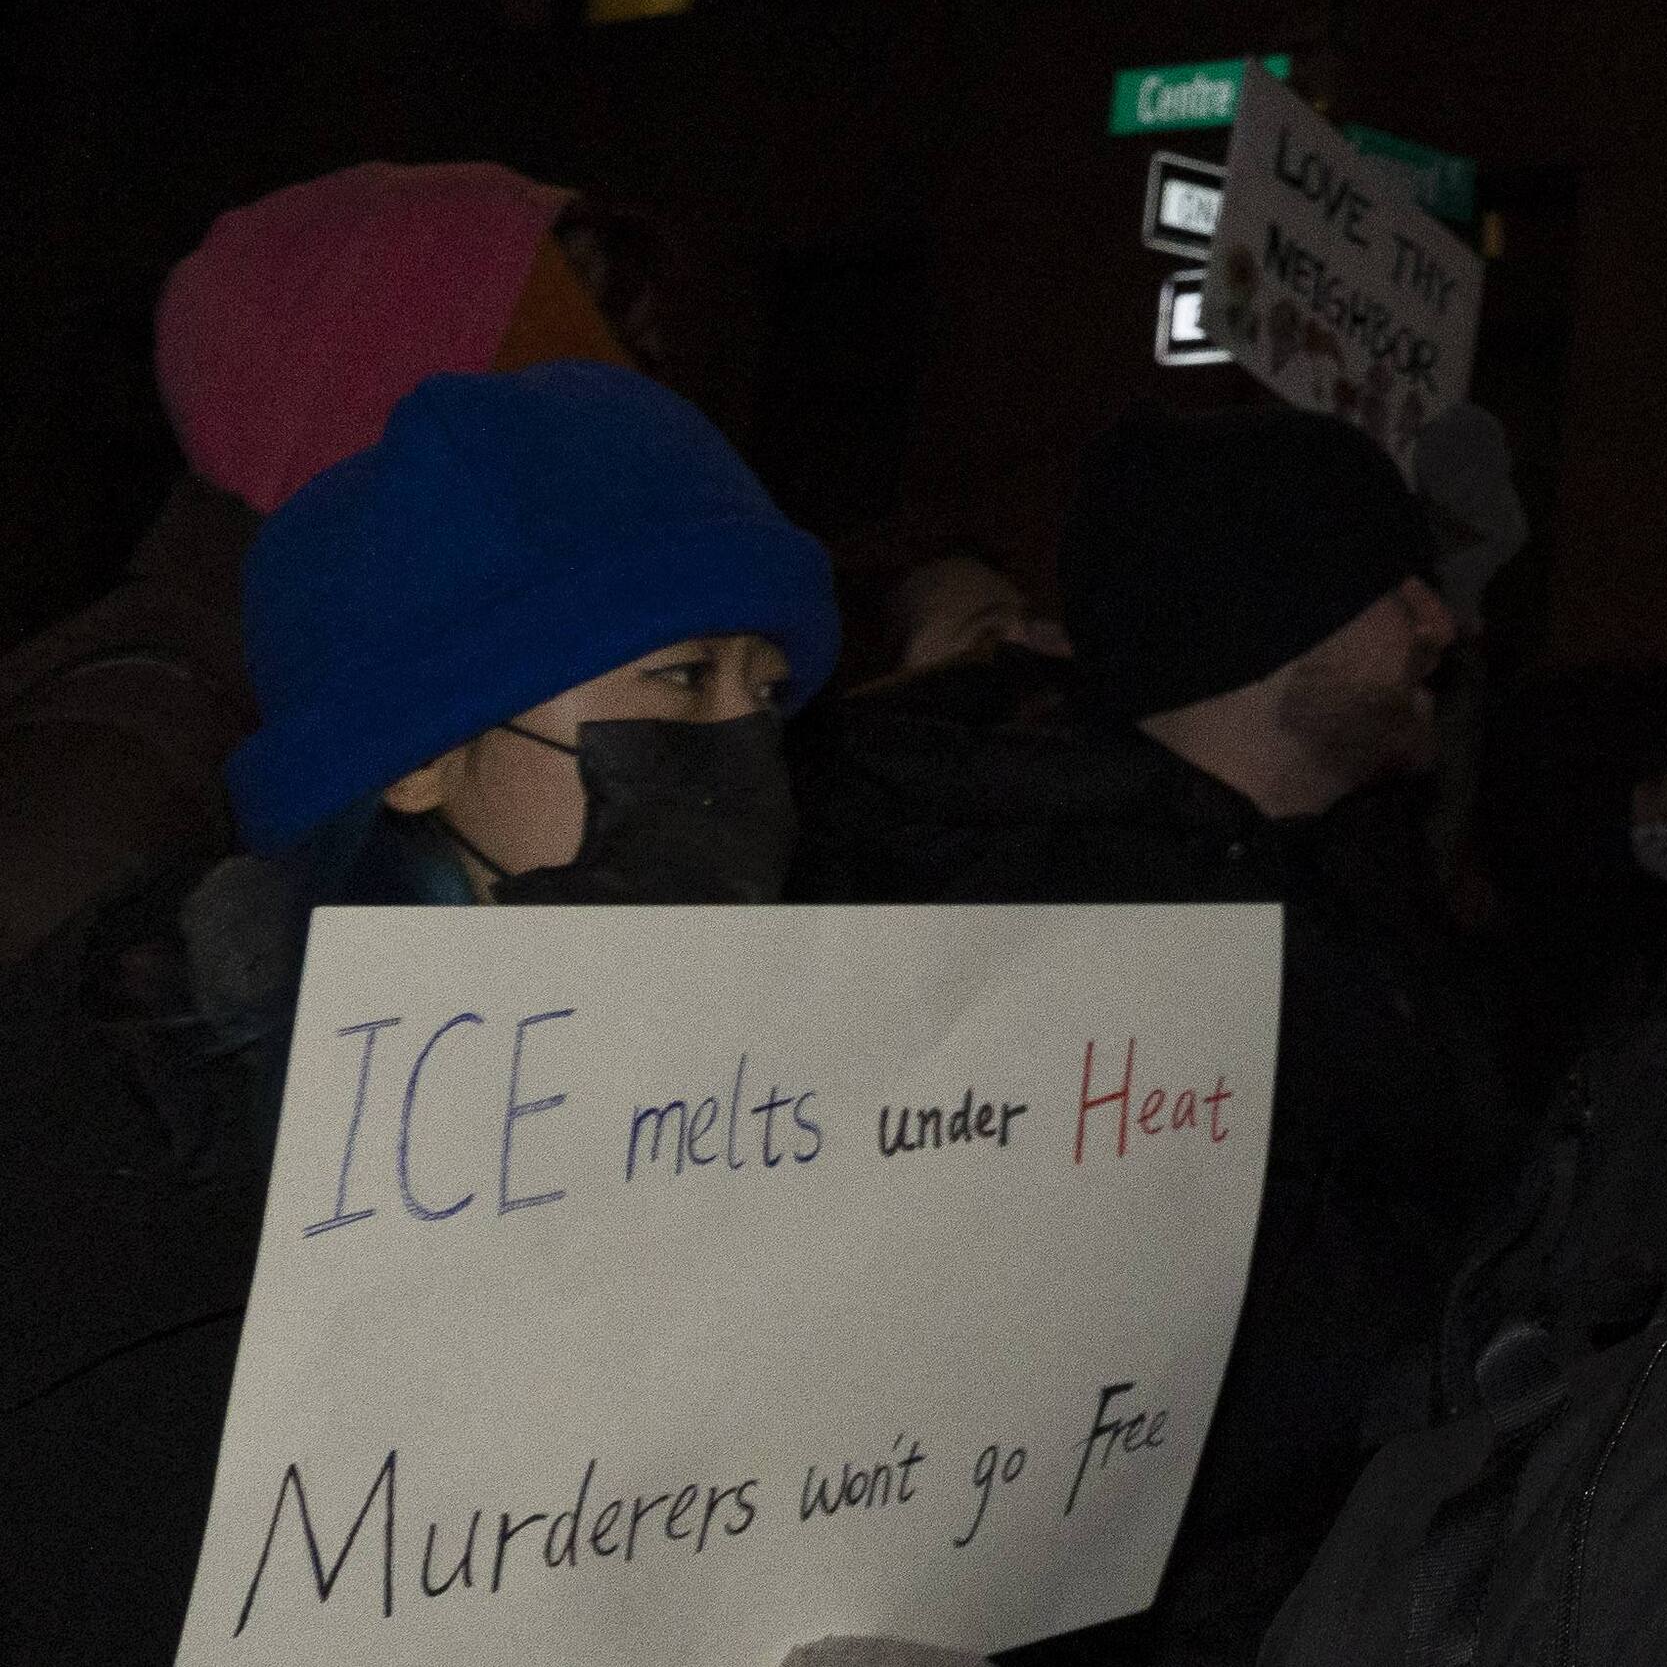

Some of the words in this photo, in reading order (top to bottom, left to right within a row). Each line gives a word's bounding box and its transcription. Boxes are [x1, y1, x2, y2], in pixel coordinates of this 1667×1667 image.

[1273, 126, 1373, 250] LOVE
[1390, 232, 1460, 316] THY
[302, 1008, 577, 1238] ICE
[624, 1053, 825, 1184] melts
[876, 1096, 1029, 1159] under
[1073, 1036, 1235, 1165] Heat
[233, 1448, 760, 1640] Murderers
[799, 1432, 927, 1525] won't
[952, 1442, 1028, 1550] go
[1064, 1381, 1170, 1518] Free
